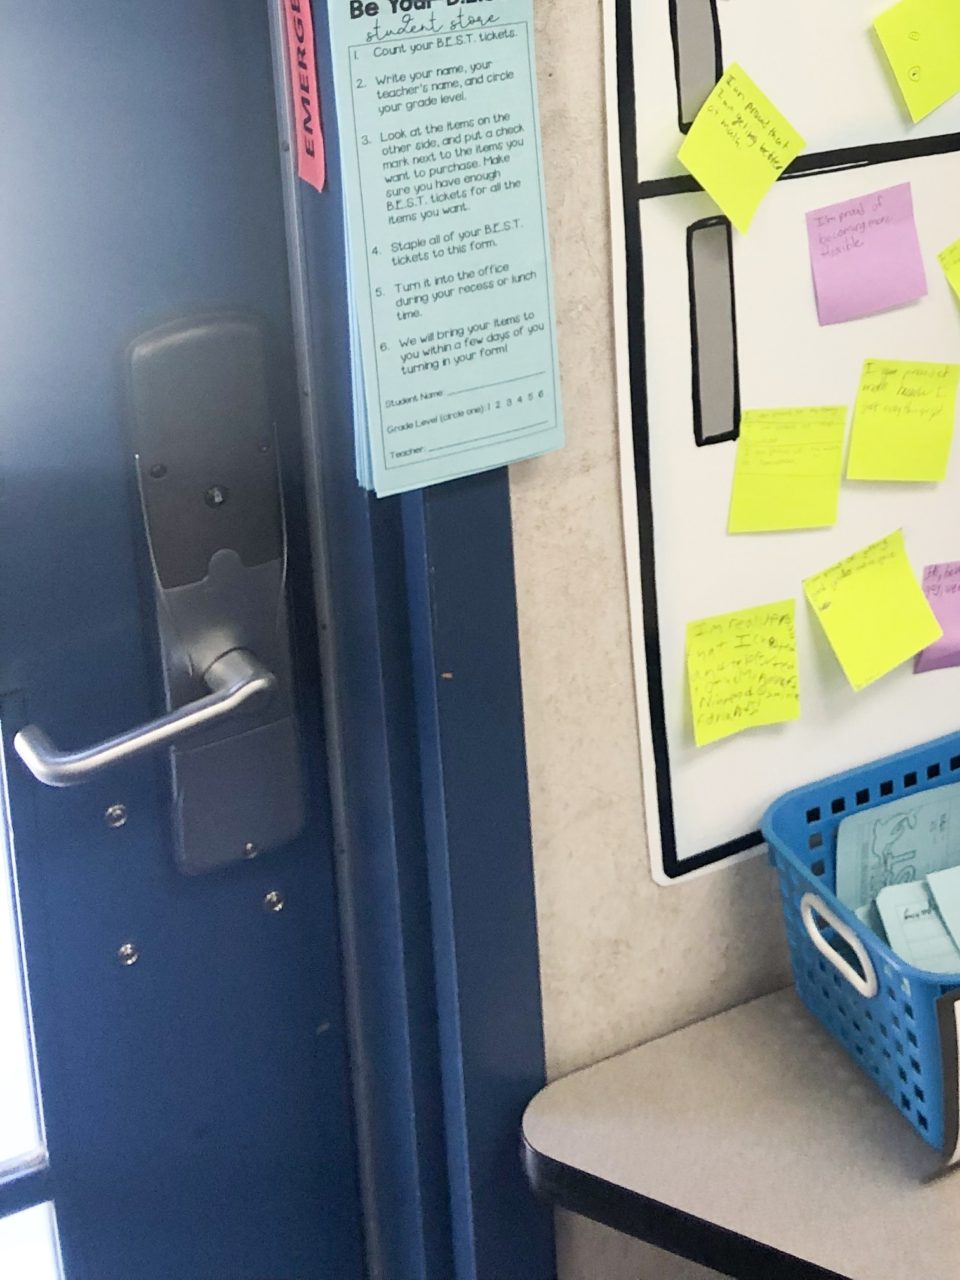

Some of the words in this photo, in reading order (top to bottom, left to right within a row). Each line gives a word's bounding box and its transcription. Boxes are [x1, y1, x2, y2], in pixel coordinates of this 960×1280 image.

[350, 0, 379, 19] Be
[366, 11, 443, 42] student
[449, 7, 500, 31] store
[374, 44, 407, 58] Count
[410, 41, 434, 54] your
[479, 28, 518, 42] tickets.
[375, 73, 406, 86] Write
[410, 69, 433, 82] your
[471, 60, 493, 73] your
[465, 75, 484, 86] and
[487, 71, 514, 82] circle
[378, 102, 402, 115] your
[406, 98, 437, 111] grade
[380, 129, 407, 143] Look
[410, 127, 422, 137] at
[425, 123, 443, 135] the
[446, 118, 474, 132] items
[477, 116, 490, 125] on
[493, 112, 510, 124] the
[382, 142, 411, 155] other
[443, 134, 461, 146] and
[465, 130, 483, 143] put
[496, 124, 525, 137] check
[383, 157, 410, 170] mark
[413, 153, 435, 165] next
[440, 149, 451, 159] to
[454, 146, 472, 157] the
[475, 141, 503, 154] items
[506, 138, 524, 150] you
[384, 171, 410, 183] want
[414, 168, 426, 178] to
[483, 153, 510, 167] Make
[386, 186, 410, 198] sure
[414, 183, 432, 196] you
[435, 177, 460, 190] have
[464, 169, 500, 185] enough
[430, 189, 467, 204] tickets
[471, 186, 487, 197] for
[504, 178, 521, 190] the
[388, 210, 417, 225] items
[421, 208, 439, 221] you
[391, 238, 426, 254] Staple
[429, 235, 440, 246] all
[444, 232, 455, 242] of
[458, 228, 481, 241] your
[392, 251, 429, 266] tickets
[433, 247, 444, 258] to
[448, 242, 466, 255] this
[457, 269, 475, 280] the
[478, 262, 509, 277] office
[395, 292, 429, 308] during
[432, 289, 454, 302] your
[458, 281, 494, 294] recess
[497, 277, 508, 287] or
[511, 270, 537, 285] lunch
[399, 335, 416, 348] We
[420, 331, 434, 344] will
[437, 327, 464, 341] bring
[467, 321, 490, 335] your
[494, 314, 520, 328] items
[523, 311, 534, 321] to
[401, 351, 419, 363] you
[423, 342, 451, 356] within
[464, 336, 483, 349] few
[486, 330, 510, 344] days
[527, 323, 544, 336] you
[401, 359, 439, 375] turning
[454, 352, 476, 366] your
